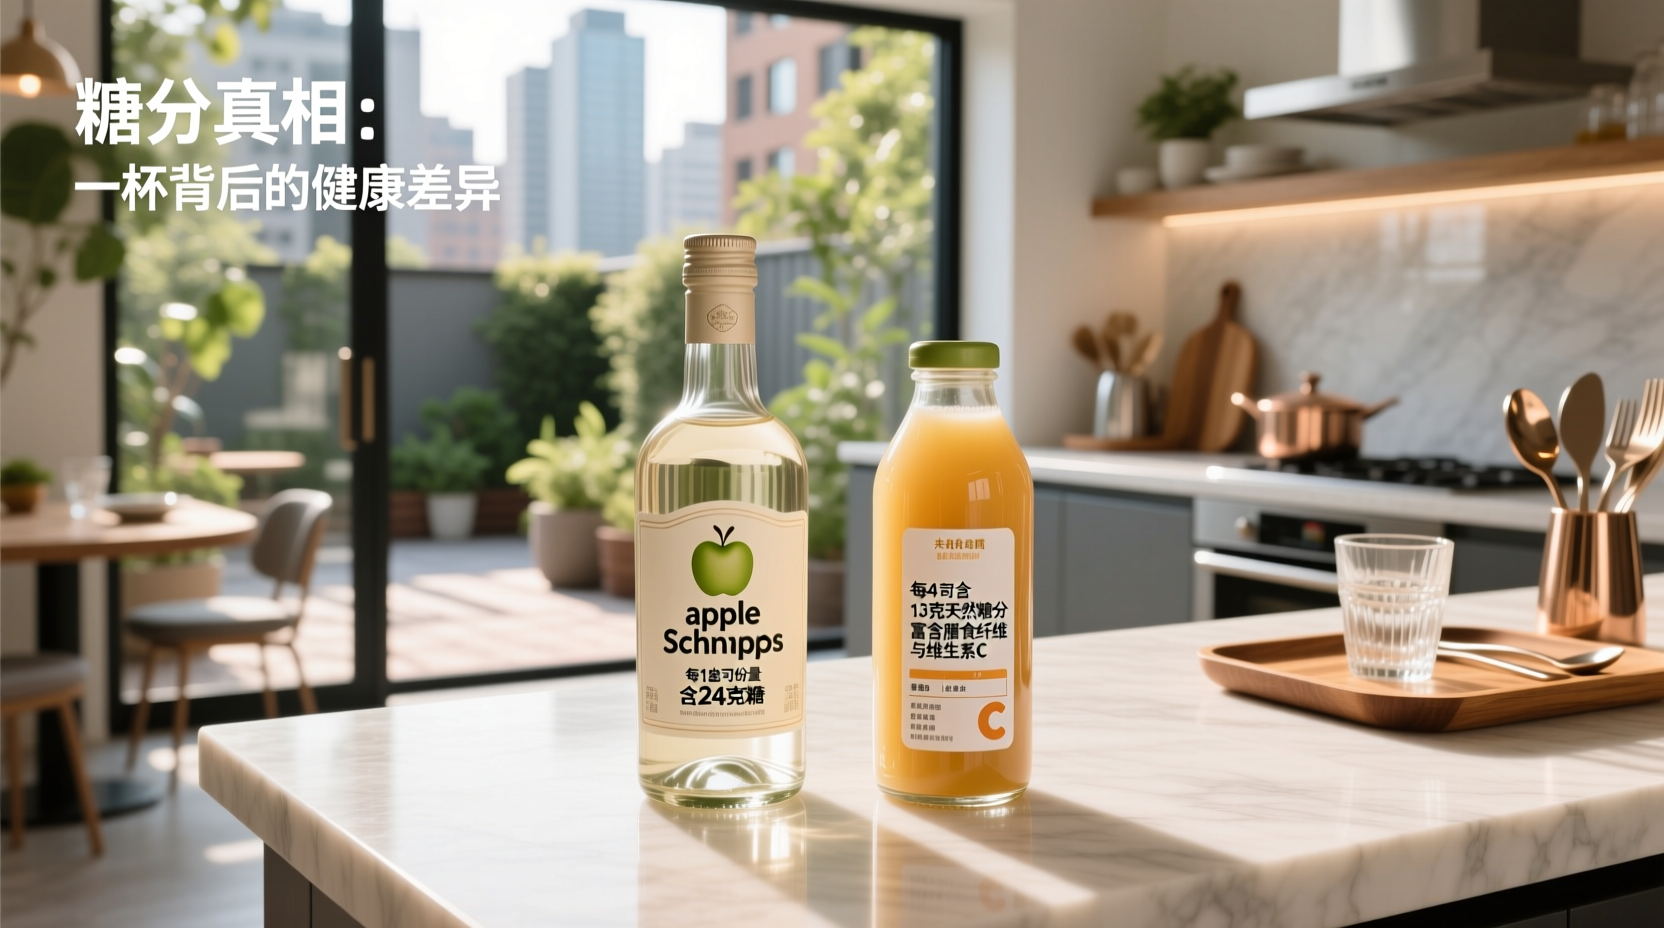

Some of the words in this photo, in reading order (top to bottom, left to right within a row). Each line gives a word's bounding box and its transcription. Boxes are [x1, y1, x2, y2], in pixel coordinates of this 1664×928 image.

[685, 600, 761, 632] apple
[679, 685, 766, 706] 含24克糖
[977, 701, 1006, 741] C
